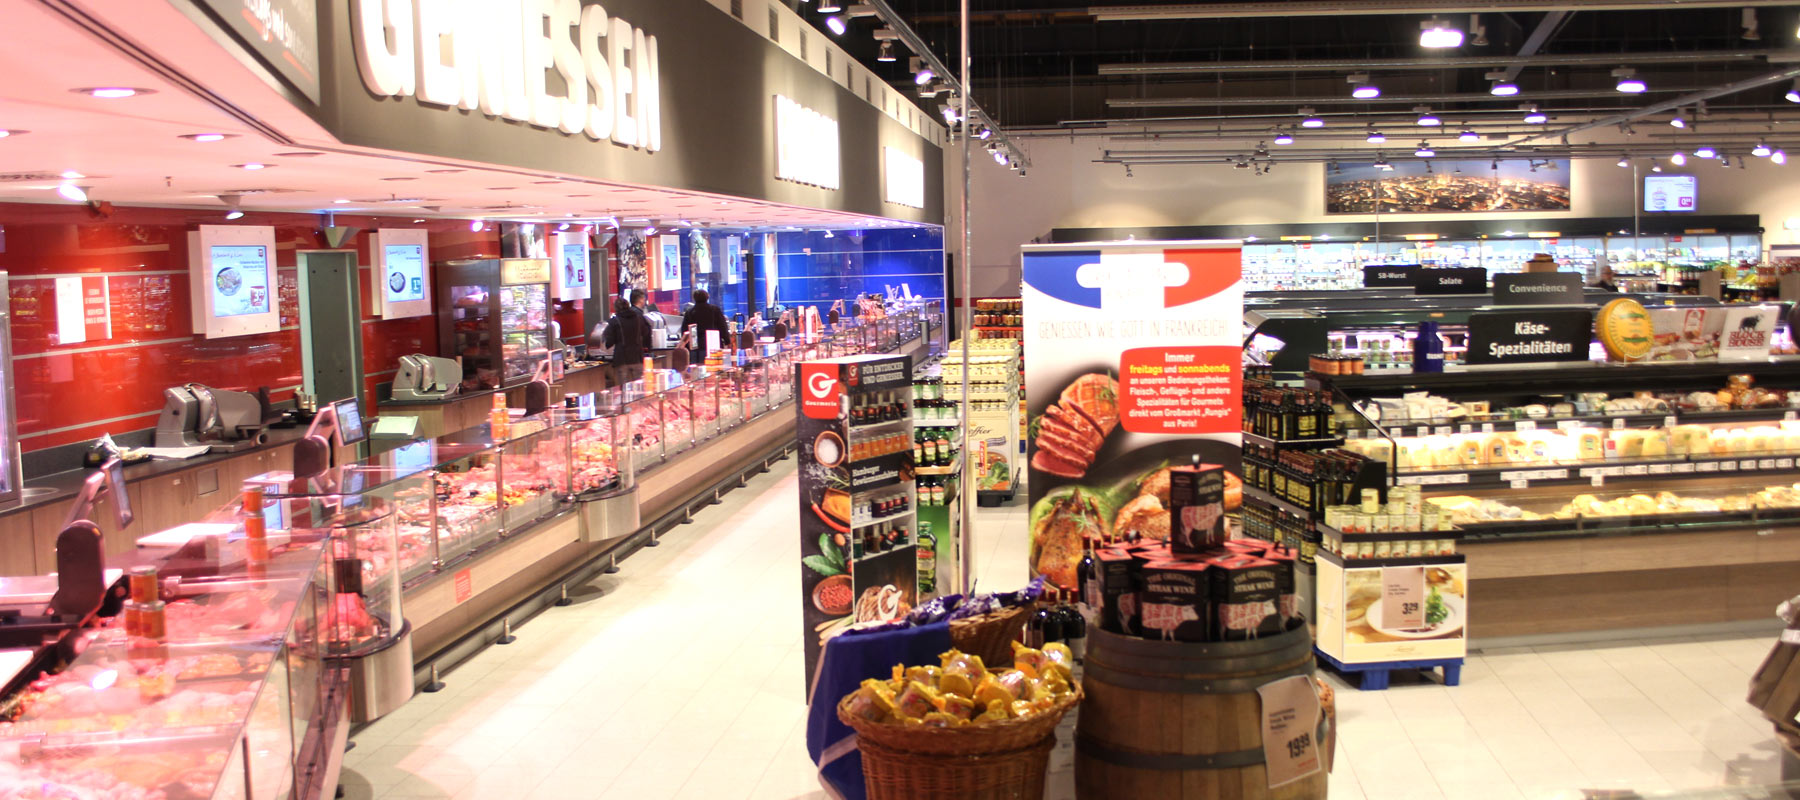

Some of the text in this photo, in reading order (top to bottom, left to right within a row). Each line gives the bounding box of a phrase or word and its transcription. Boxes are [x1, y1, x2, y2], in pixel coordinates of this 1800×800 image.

[1438, 276, 1463, 286] Salate
[1508, 284, 1568, 293] Convenience
[1514, 321, 1550, 336] Käse-
[1728, 331, 1766, 340] BLOCK
[1727, 339, 1764, 348] HOUSE
[1489, 340, 1573, 359] Spezialitäten
[1164, 352, 1195, 363] Immer
[1129, 364, 1231, 376] freitags und sonnabends
[1140, 377, 1166, 385] unseren
[1192, 387, 1205, 395] und
[1206, 387, 1231, 395] andere
[1136, 398, 1180, 408] Spezialitäten
[1180, 398, 1190, 406] für
[1129, 409, 1149, 418] direkt
[1163, 419, 1197, 428] aus Paris!
[1147, 584, 1197, 595] STEAK WINE
[1233, 580, 1276, 594] STEAK WINE
